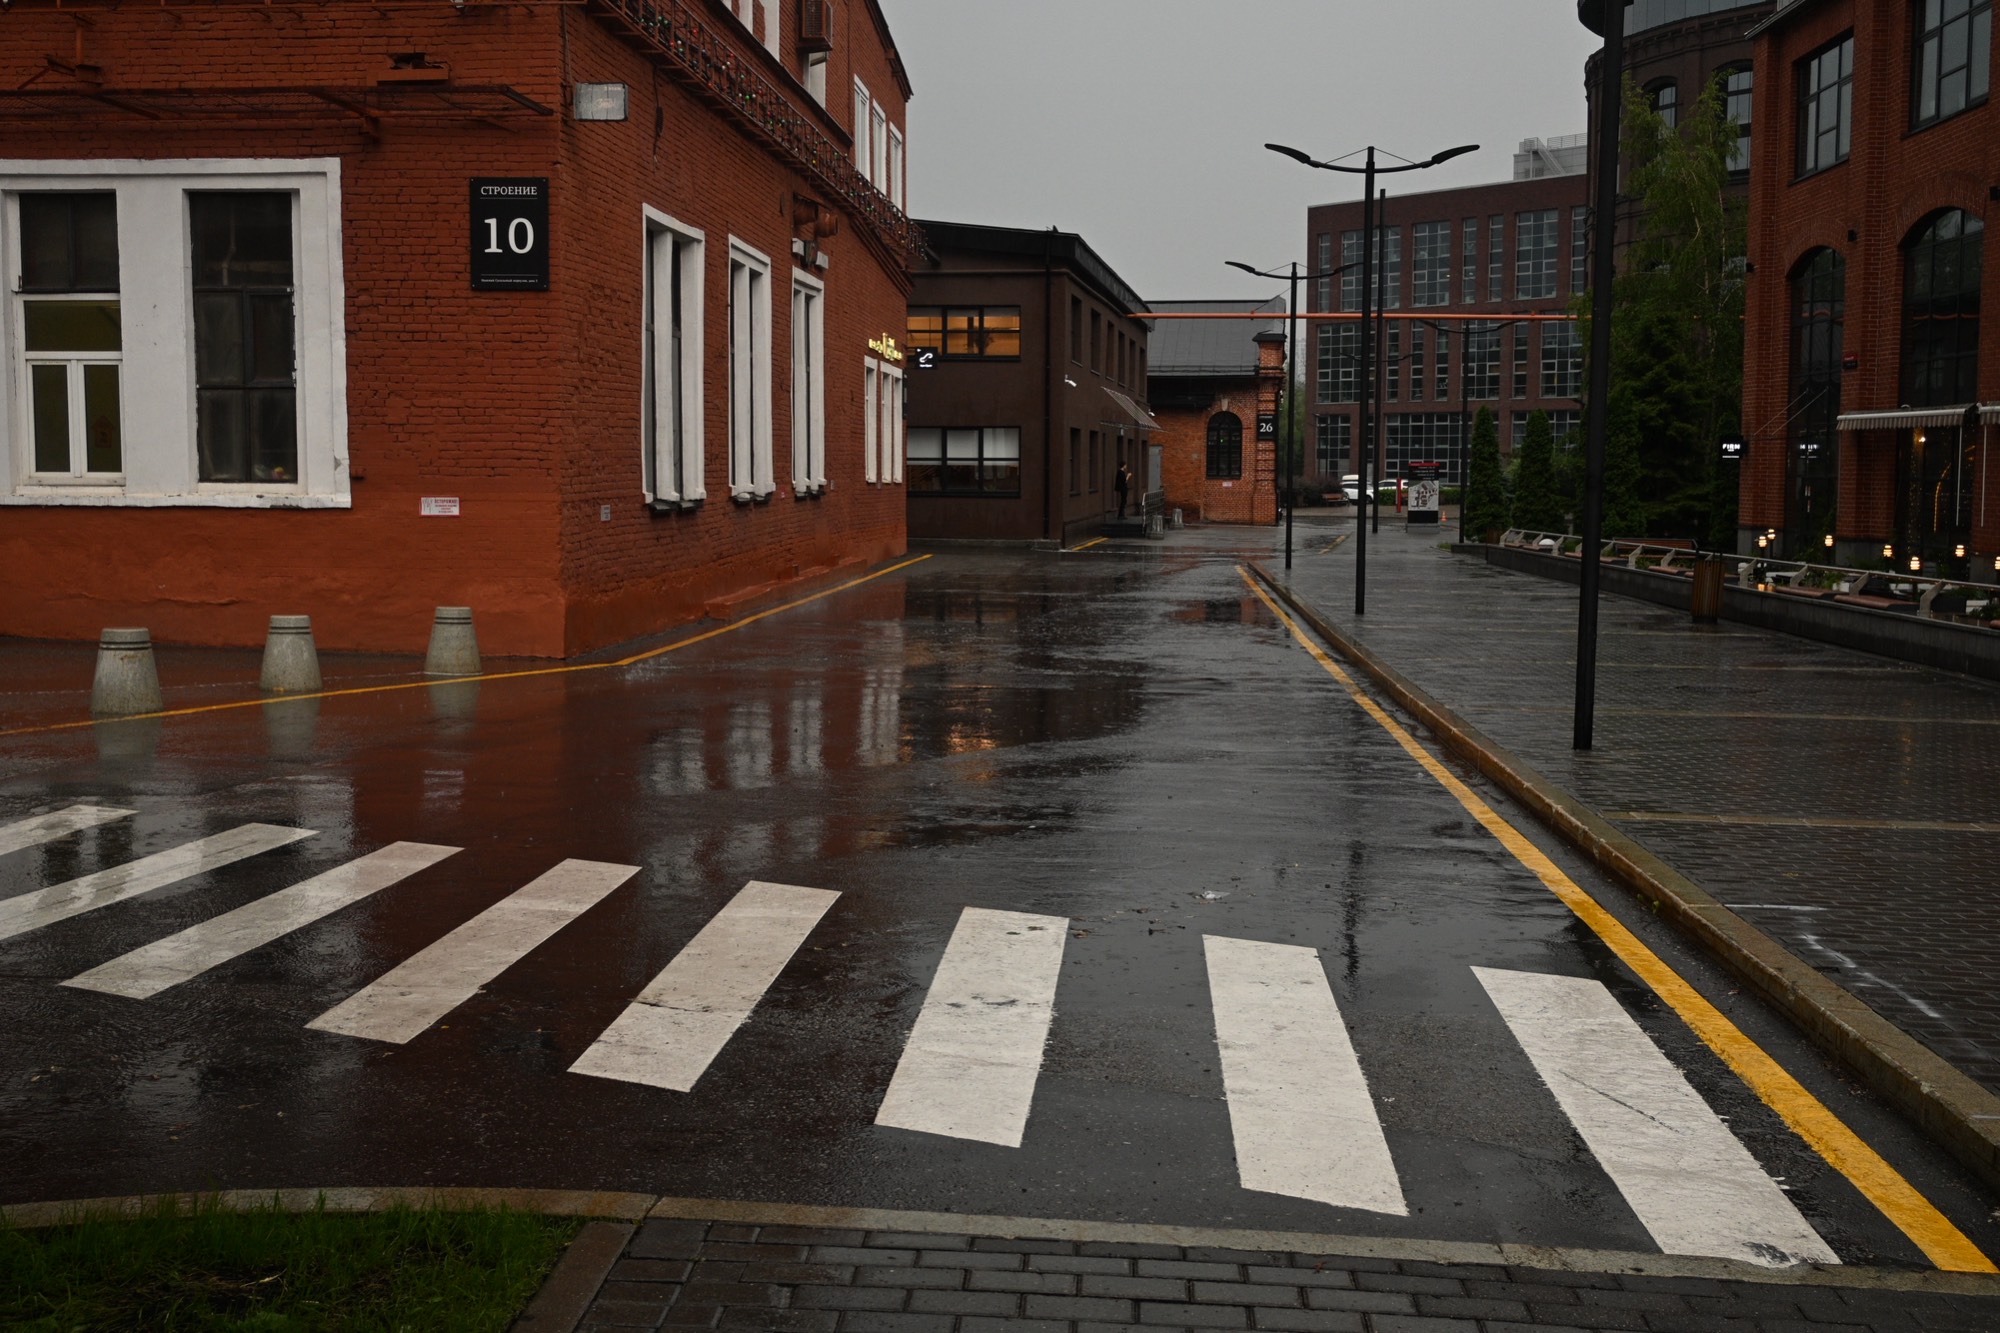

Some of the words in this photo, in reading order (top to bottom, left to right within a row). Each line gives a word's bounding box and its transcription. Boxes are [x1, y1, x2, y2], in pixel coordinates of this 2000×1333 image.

[480, 186, 538, 196] СТРОЕНИЕ
[484, 217, 535, 255] 10
[1259, 422, 1273, 433] 26
